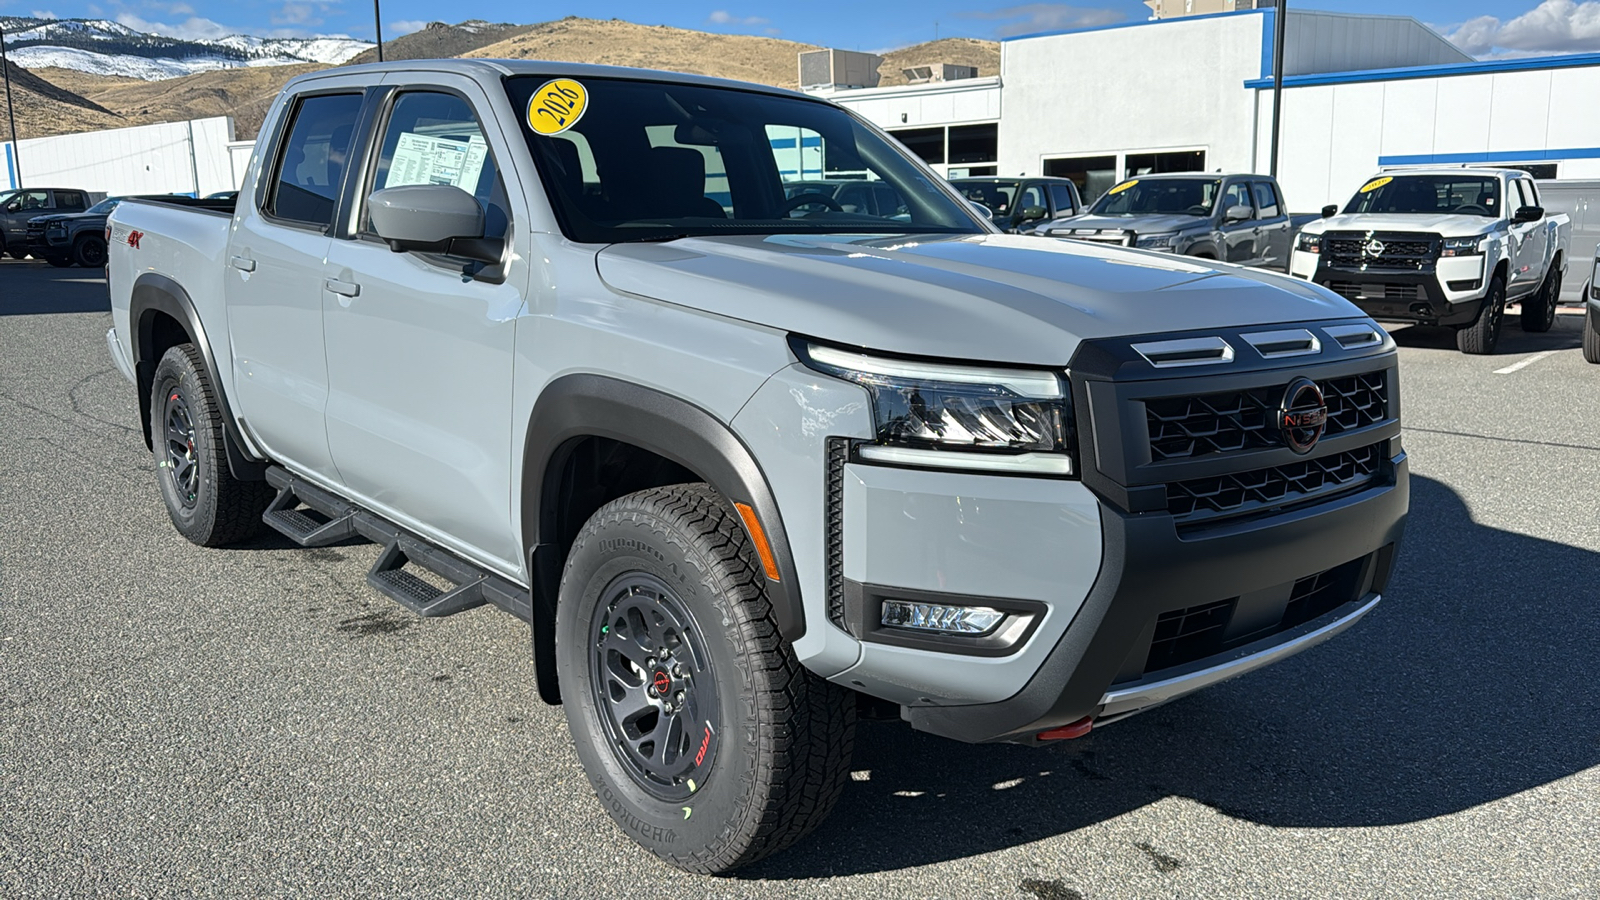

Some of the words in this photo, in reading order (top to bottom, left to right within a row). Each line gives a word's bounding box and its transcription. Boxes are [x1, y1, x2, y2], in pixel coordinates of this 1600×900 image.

[537, 83, 579, 126] 2026
[599, 538, 664, 562] Dynapro
[695, 727, 710, 767] PRO
[596, 774, 663, 842] Hankook
